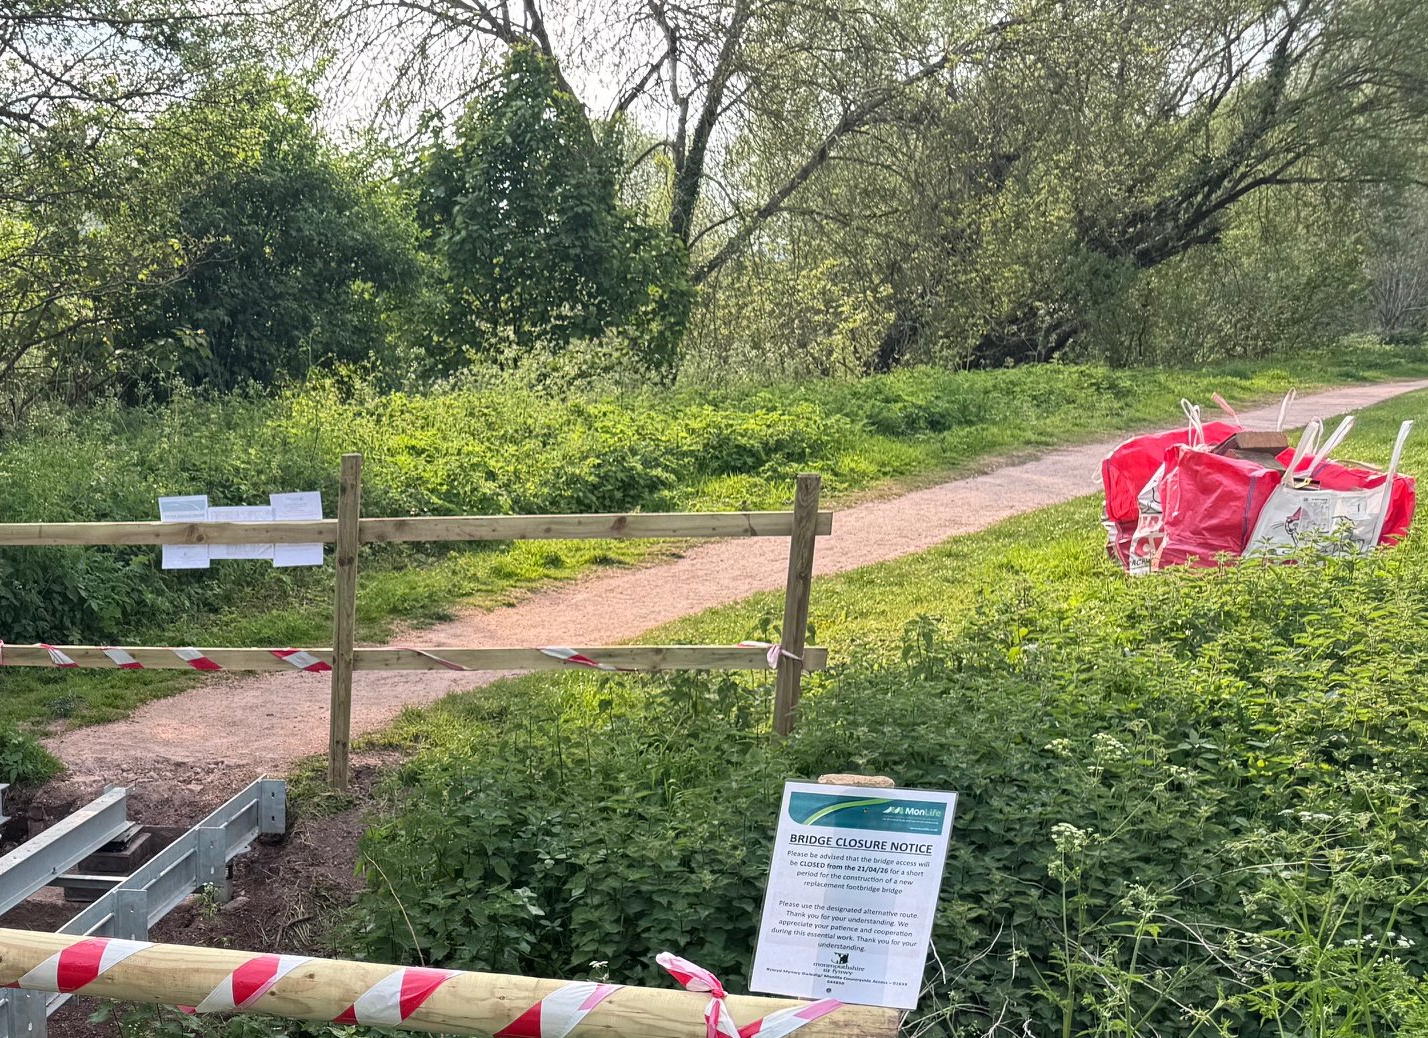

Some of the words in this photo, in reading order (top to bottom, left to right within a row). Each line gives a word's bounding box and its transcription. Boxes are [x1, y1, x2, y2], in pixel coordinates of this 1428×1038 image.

[905, 807, 941, 817] MonLife
[790, 834, 832, 845] BRIDGE
[836, 838, 888, 850] CLOSURE
[890, 842, 933, 854] NOTICE
[857, 866, 888, 874] 21/04/26
[804, 881, 845, 889] replacement
[846, 884, 880, 893] footbridge
[826, 905, 862, 914] designated
[863, 909, 898, 917] alternative
[848, 917, 895, 927] understanding.
[771, 927, 792, 935] during
[818, 942, 866, 952] understanding.
[813, 962, 865, 971] monmouthshire
